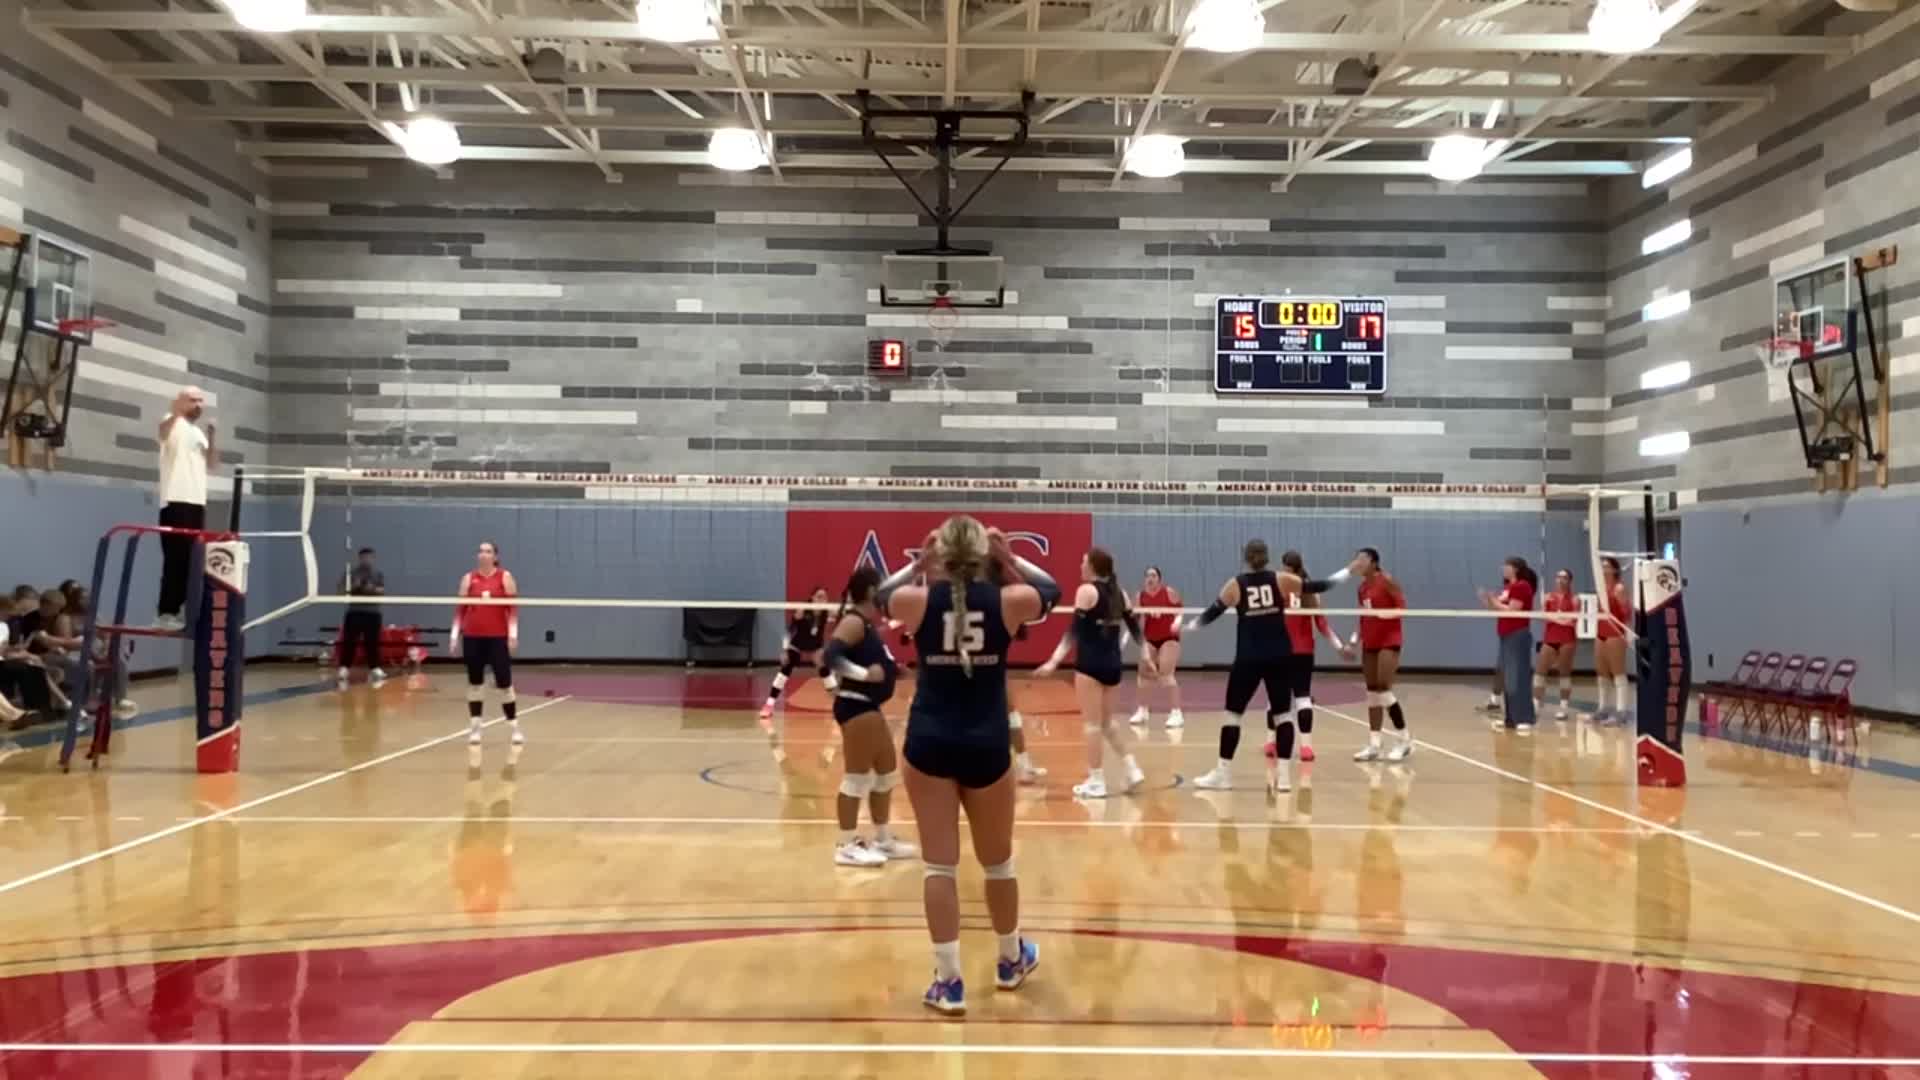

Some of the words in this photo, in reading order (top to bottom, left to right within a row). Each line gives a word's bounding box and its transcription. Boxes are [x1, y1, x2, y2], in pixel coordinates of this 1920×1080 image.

[1224, 302, 1254, 312] HOME
[1344, 302, 1383, 313] VISITOR
[1279, 303, 1336, 325] 0:00
[1235, 315, 1256, 338] 15
[1359, 315, 1381, 339] 17
[1279, 336, 1307, 345] PERIOD
[884, 343, 900, 367] 0
[1230, 355, 1253, 363] FOULS
[1276, 355, 1303, 363] PLAYER
[1308, 355, 1332, 364] FOULS
[1347, 356, 1371, 364] FOULS
[536, 474, 591, 482] AMERICAN
[596, 474, 628, 483] RIVER
[632, 475, 677, 483] COLLEGE
[707, 477, 763, 485] AMERICAN
[767, 477, 799, 486] RIVER
[803, 478, 847, 486] COLLEGE
[878, 479, 933, 488] AMERICAN
[937, 479, 969, 489] RIVER
[973, 480, 1018, 489] COLLEGE
[1048, 482, 1103, 490] AMERICAN
[1107, 482, 1139, 491] RIVER
[1143, 482, 1187, 491] COLLEGE
[1217, 484, 1272, 492] AMERICAN
[1276, 484, 1308, 493] RIVER
[1312, 485, 1356, 493] COLLEGE
[1386, 485, 1441, 493] AMERICAN
[1446, 485, 1478, 494] RIVER
[1482, 486, 1527, 494] COLLEGE
[1246, 584, 1274, 608] 20
[943, 611, 984, 651] 15
